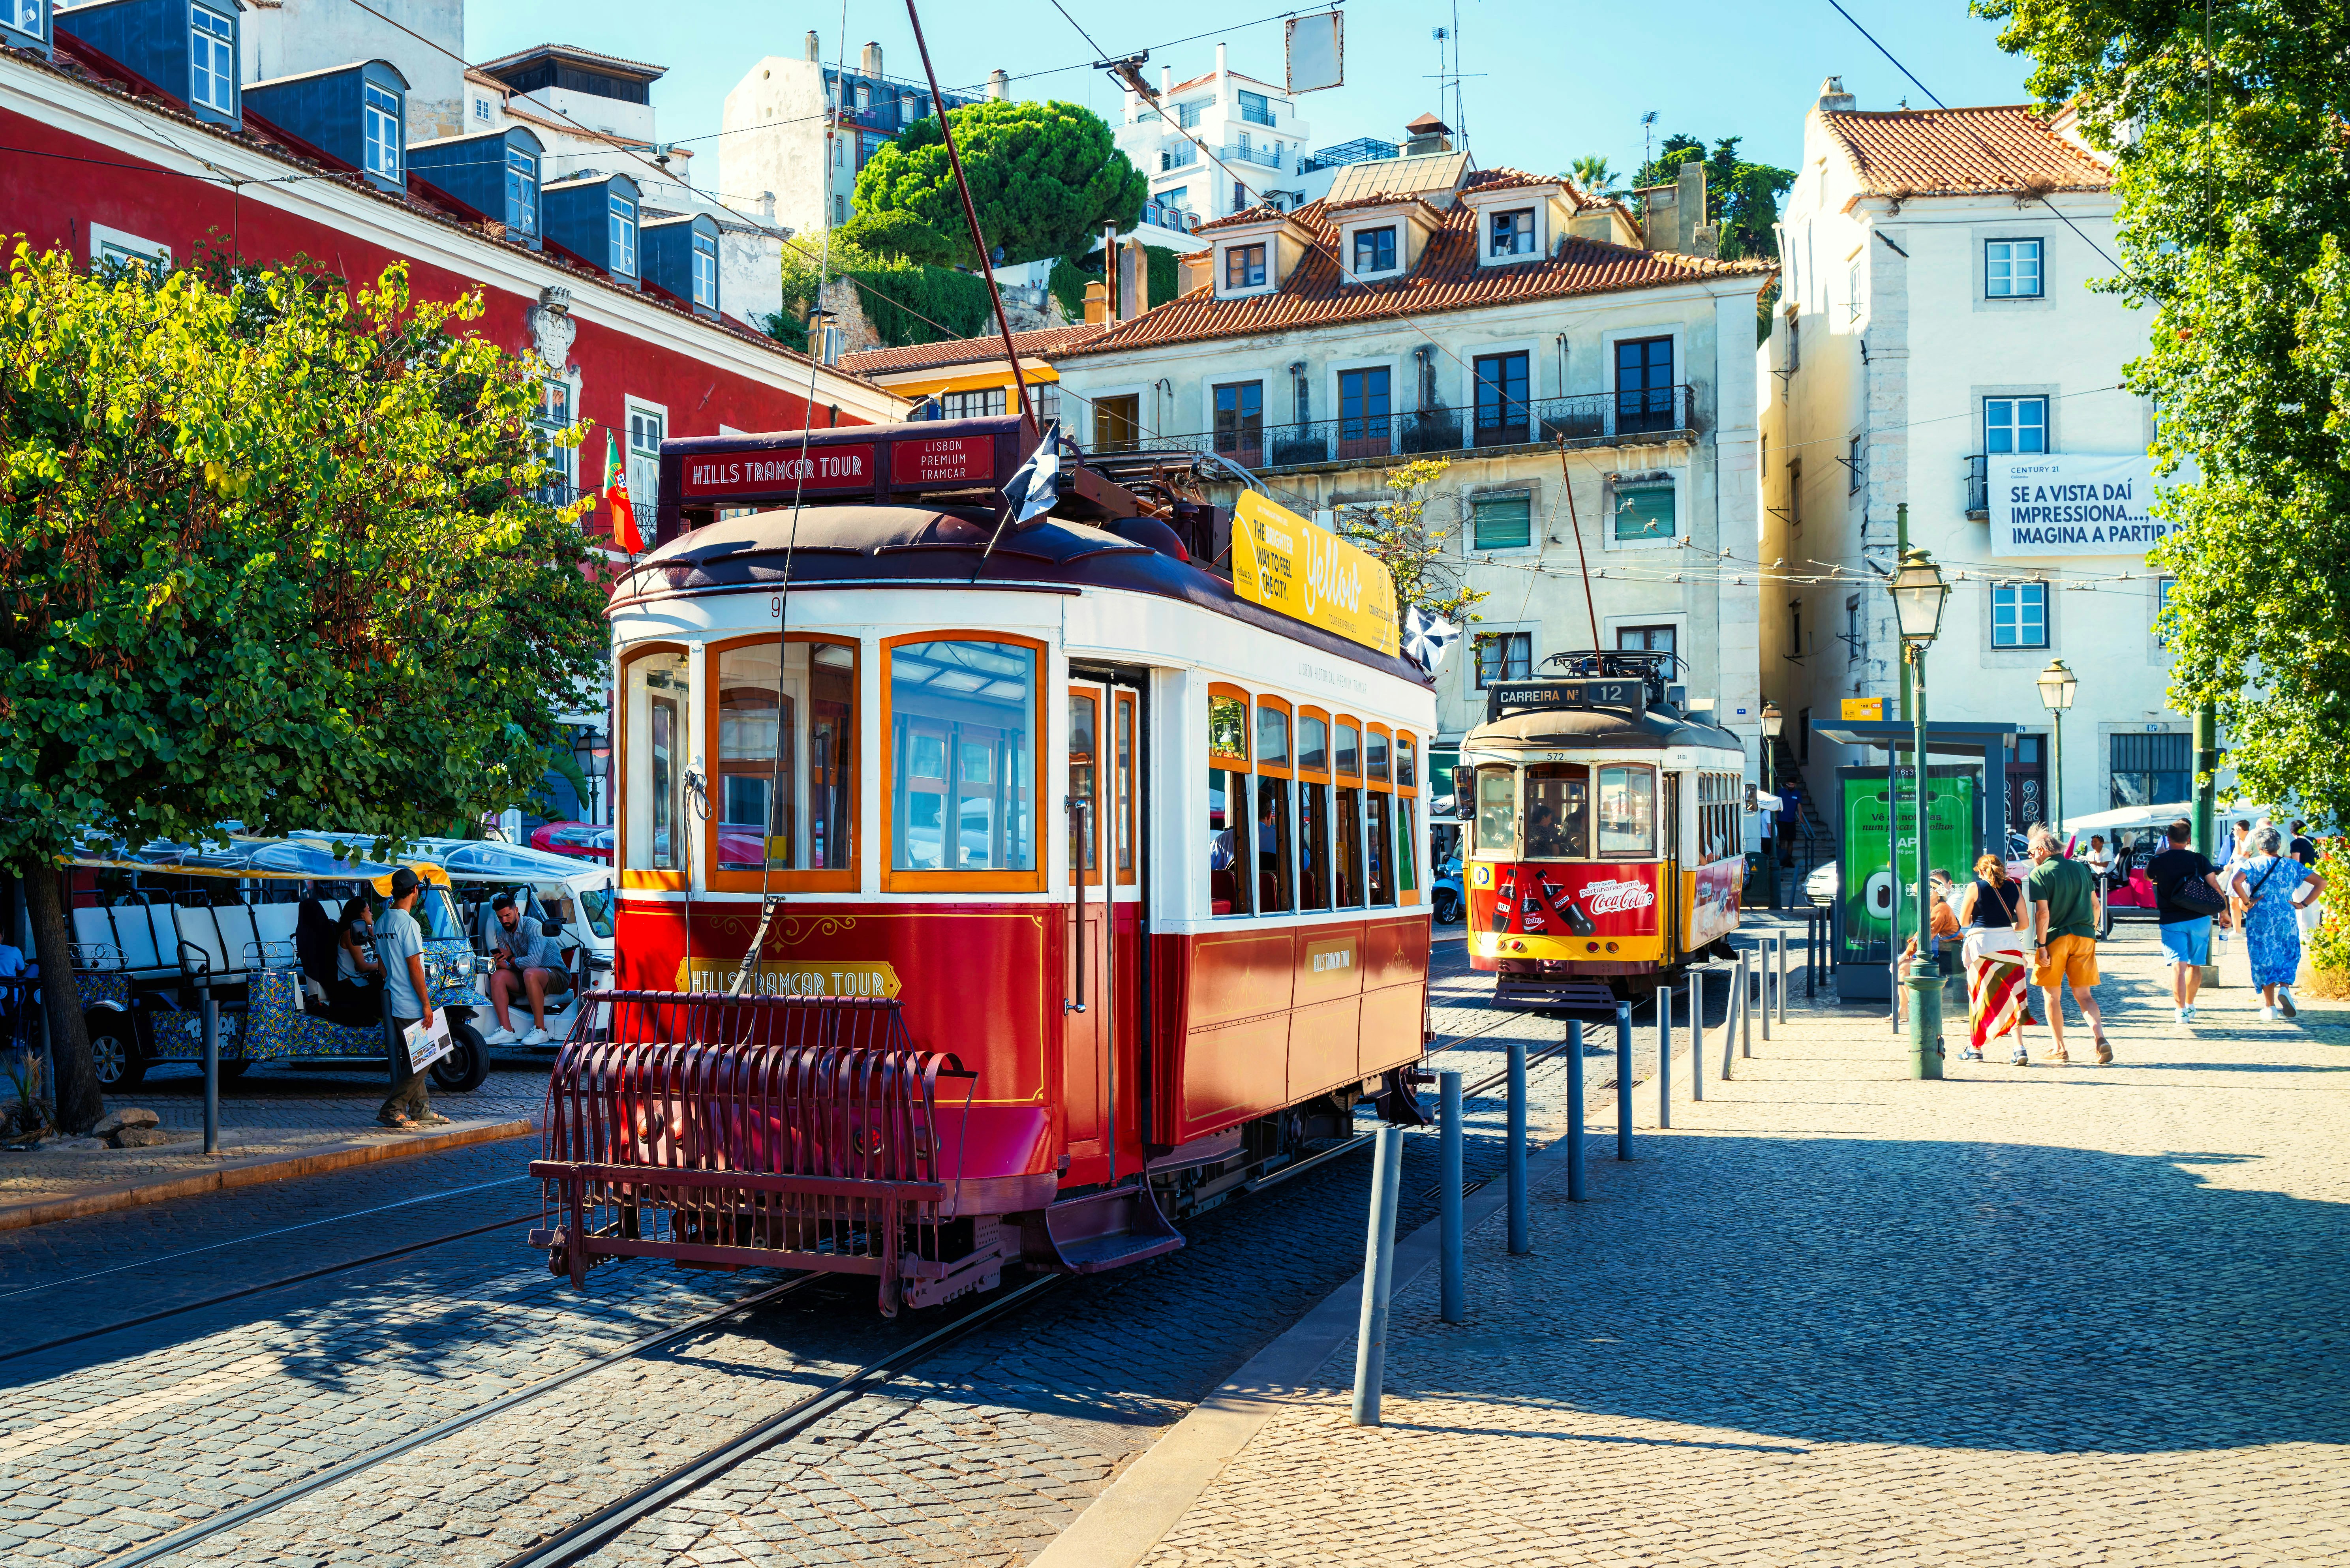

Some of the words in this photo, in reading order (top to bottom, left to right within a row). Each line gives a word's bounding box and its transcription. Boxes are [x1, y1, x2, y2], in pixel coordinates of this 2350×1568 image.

[926, 440, 961, 452] LISBON
[693, 463, 740, 485] HILLS
[744, 459, 815, 482] TRAMCAR
[819, 456, 862, 477] TOUR
[921, 454, 965, 466] PREMIUM
[921, 467, 965, 480] TRAMCAR
[2011, 486, 2029, 503] SE
[2034, 486, 2048, 502] A
[2049, 485, 2099, 501] VISTA
[2103, 477, 2132, 501] DAÍ
[1254, 519, 1265, 542] THE
[1265, 525, 1293, 555] BRIGHTER
[2013, 526, 2088, 544] IMAGINA
[2092, 526, 2105, 543] A
[2109, 524, 2166, 542] PARTIR
[1256, 545, 1270, 568] WAY
[1271, 552, 1279, 572] TO
[1280, 556, 1292, 579] FEEL
[1302, 527, 1361, 615] Yellow
[1262, 573, 1273, 595] THE
[1274, 578, 1288, 601] CITY.
[771, 596, 780, 618] 9
[1329, 613, 1337, 626] TOURS
[1337, 618, 1340, 628] &
[1340, 619, 1357, 634] EXPERIENCES
[1299, 662, 1312, 678] LISBON
[1315, 667, 1335, 685] HISTORICAL
[1337, 673, 1351, 689] PREMIUM
[1353, 679, 1367, 694] TRAMCAR
[1501, 690, 1560, 702] CARREIRA
[1601, 686, 1622, 700] 12
[1888, 837, 1917, 848] AP
[1581, 884, 1622, 896] partilharias
[1555, 896, 1569, 908] Amor
[1314, 953, 1325, 972] HILLS
[1325, 951, 1340, 971] TRAMCAR
[1340, 950, 1350, 968] TOUR
[831, 972, 885, 996] TOUR
